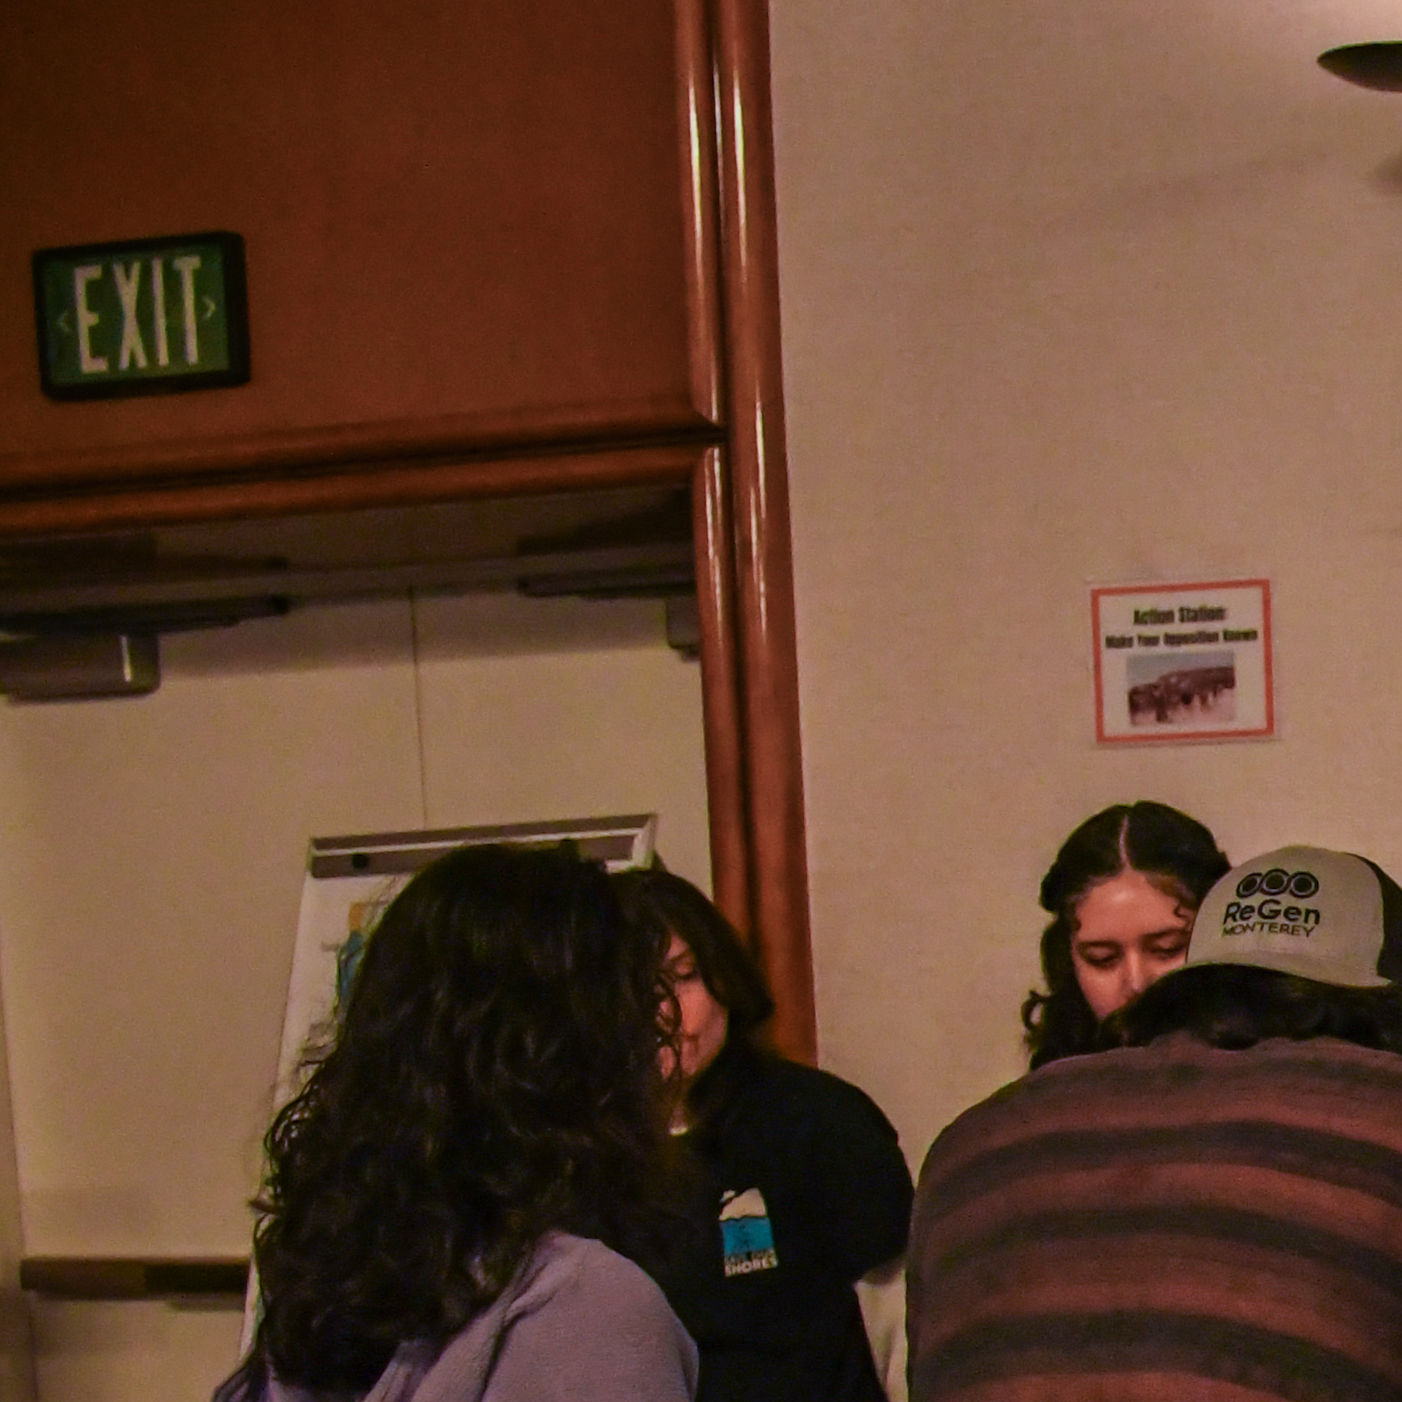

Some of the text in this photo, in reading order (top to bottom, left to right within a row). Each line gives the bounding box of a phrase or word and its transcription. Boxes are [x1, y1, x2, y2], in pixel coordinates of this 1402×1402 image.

[74, 255, 201, 374] EXIT
[1133, 608, 1175, 625] Action
[1223, 899, 1320, 925] ReGen
[1222, 921, 1315, 938] MONTEREY
[724, 1258, 778, 1277] SHORES
